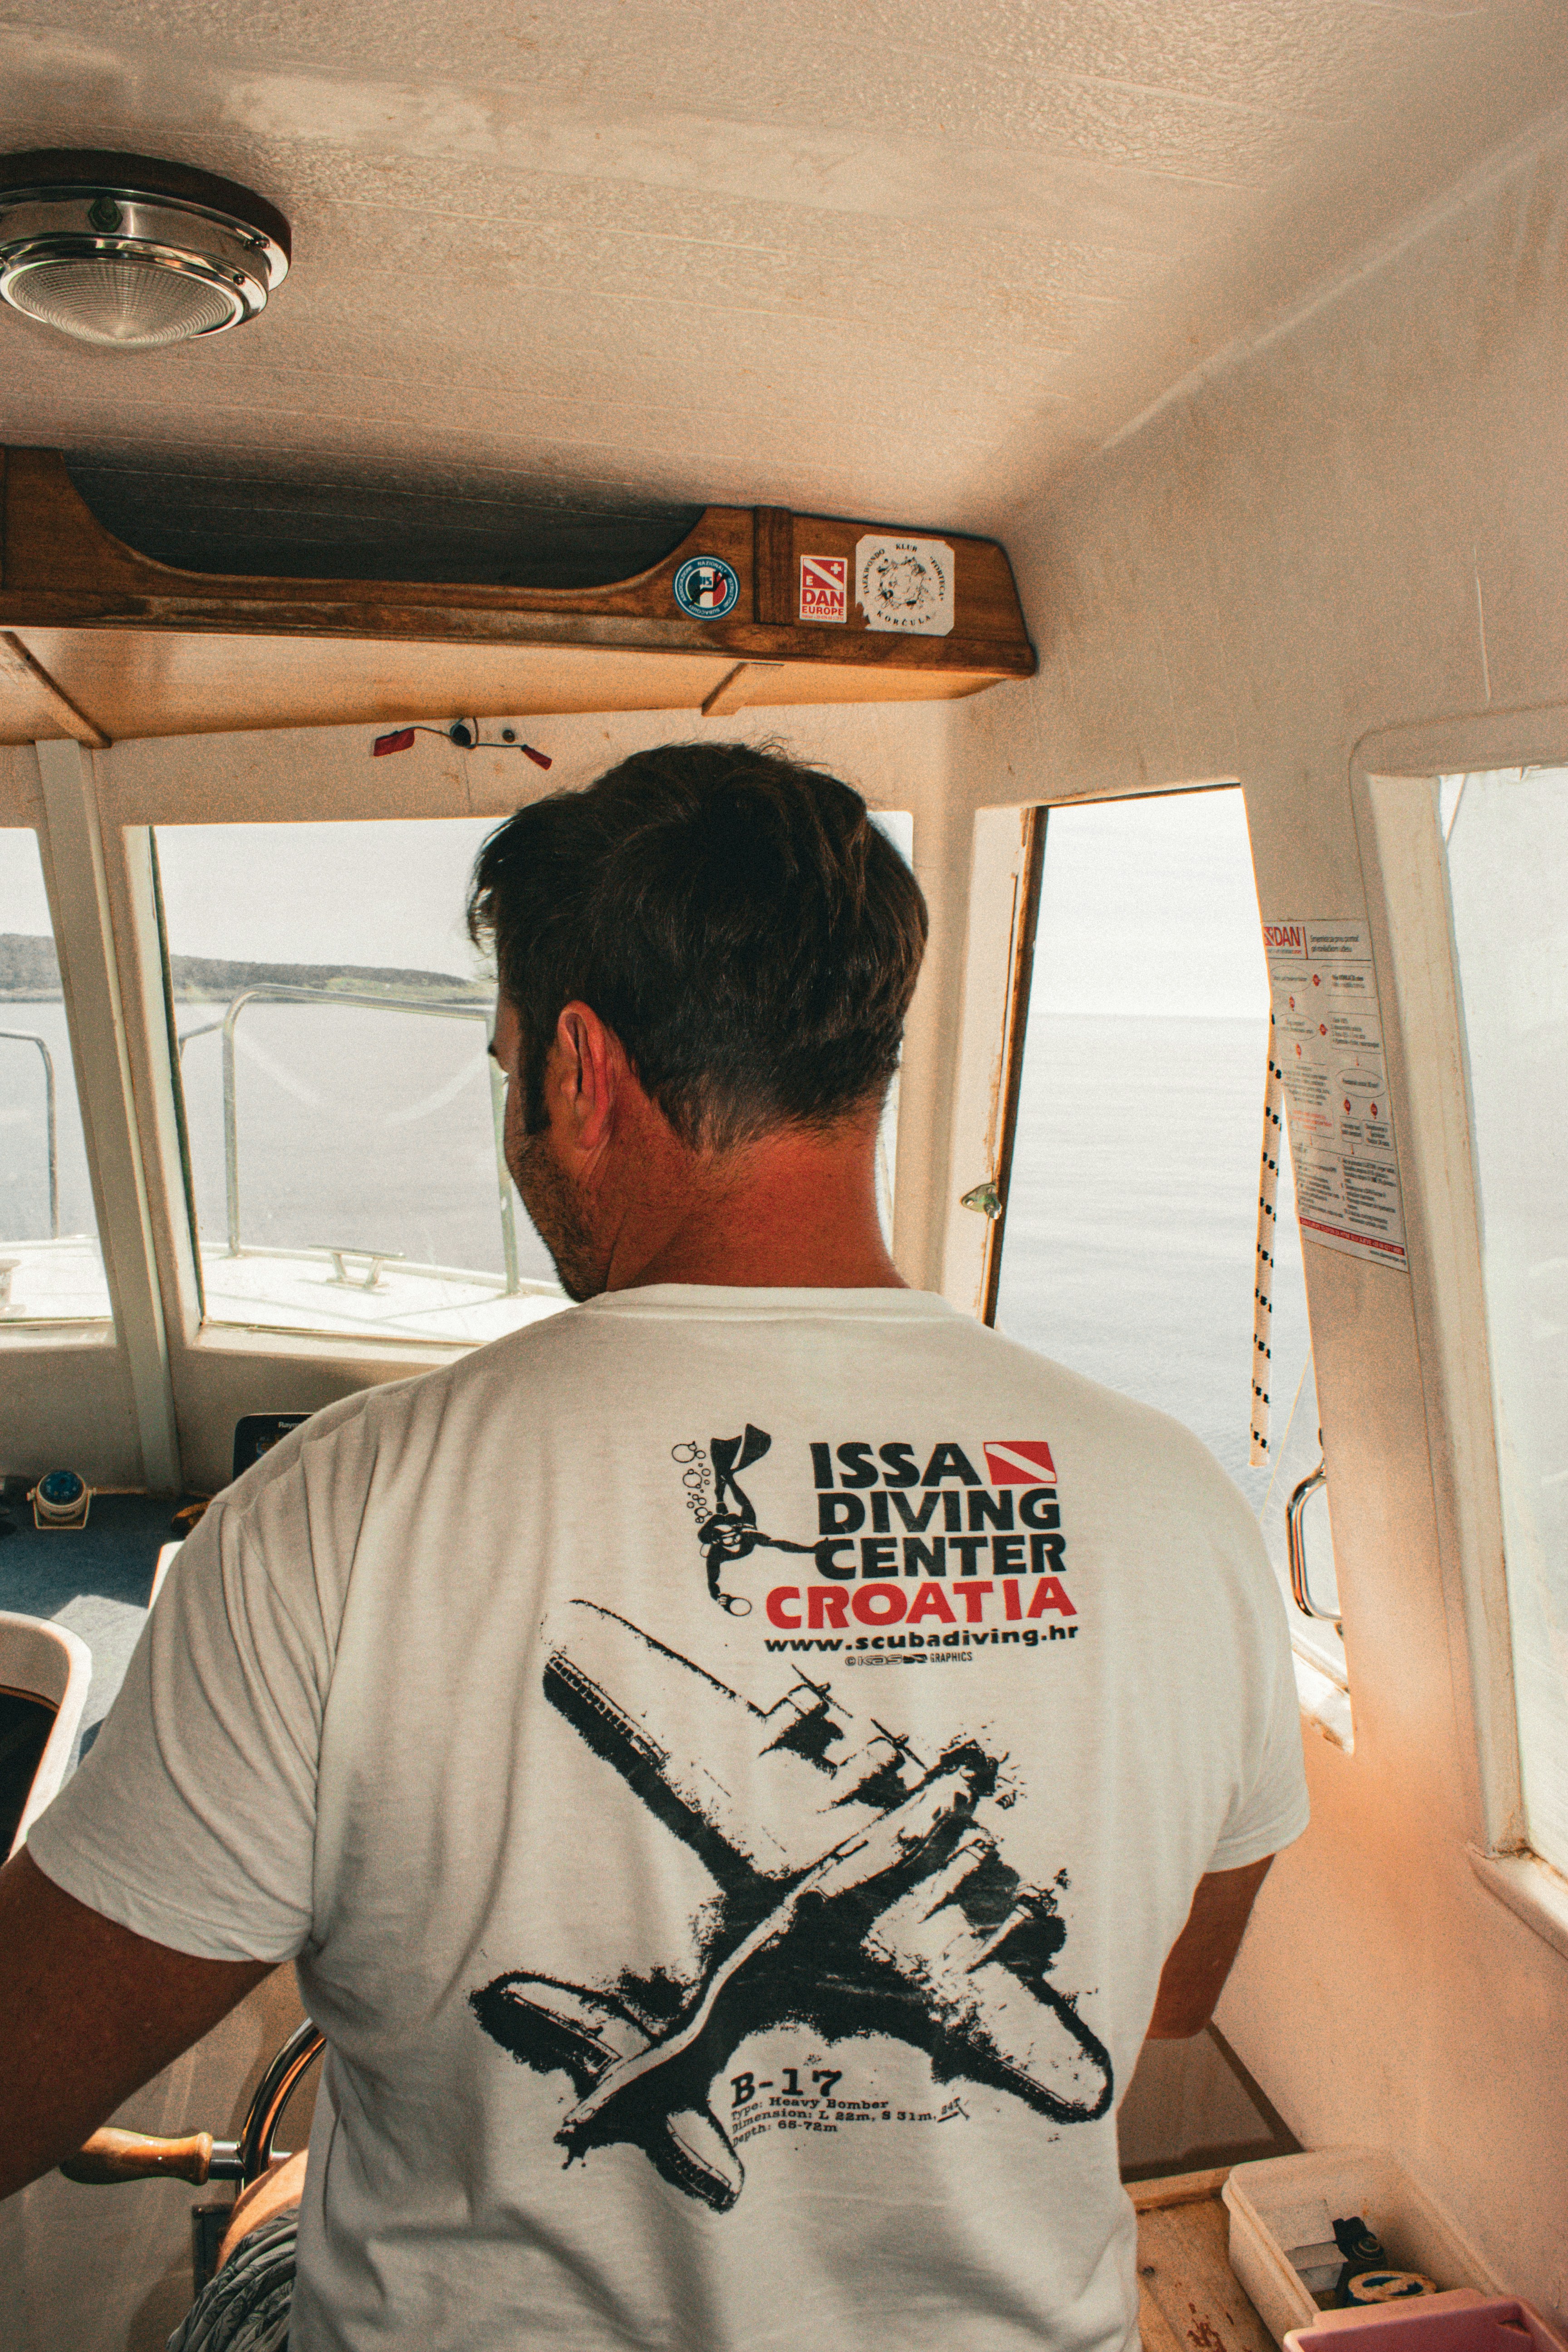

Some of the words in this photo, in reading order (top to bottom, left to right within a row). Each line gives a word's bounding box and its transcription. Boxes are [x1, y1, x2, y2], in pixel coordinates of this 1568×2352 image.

[895, 543, 917, 552] KLUB
[802, 589, 844, 607] DAN
[802, 606, 844, 616] EUROPE
[877, 610, 931, 626] KORČULA
[1274, 926, 1300, 946] DAN
[809, 1442, 982, 1489] ISSA
[818, 1488, 1060, 1535] DIVING
[815, 1533, 1067, 1580] CENTER
[766, 1577, 1078, 1629] CROATIA
[764, 1625, 1078, 1652] www.scubadiving.hr
[930, 1651, 973, 1663] GRAPHICS
[730, 2068, 842, 2108] B-17
[731, 2102, 762, 2121] Type:
[769, 2097, 819, 2108] Heavy
[826, 2098, 888, 2109] Bomber
[732, 2108, 812, 2133] Dimension:
[818, 2110, 829, 2120] L
[835, 2111, 876, 2122] 22m,
[882, 2111, 891, 2120] S
[732, 2123, 771, 2148] Depth:
